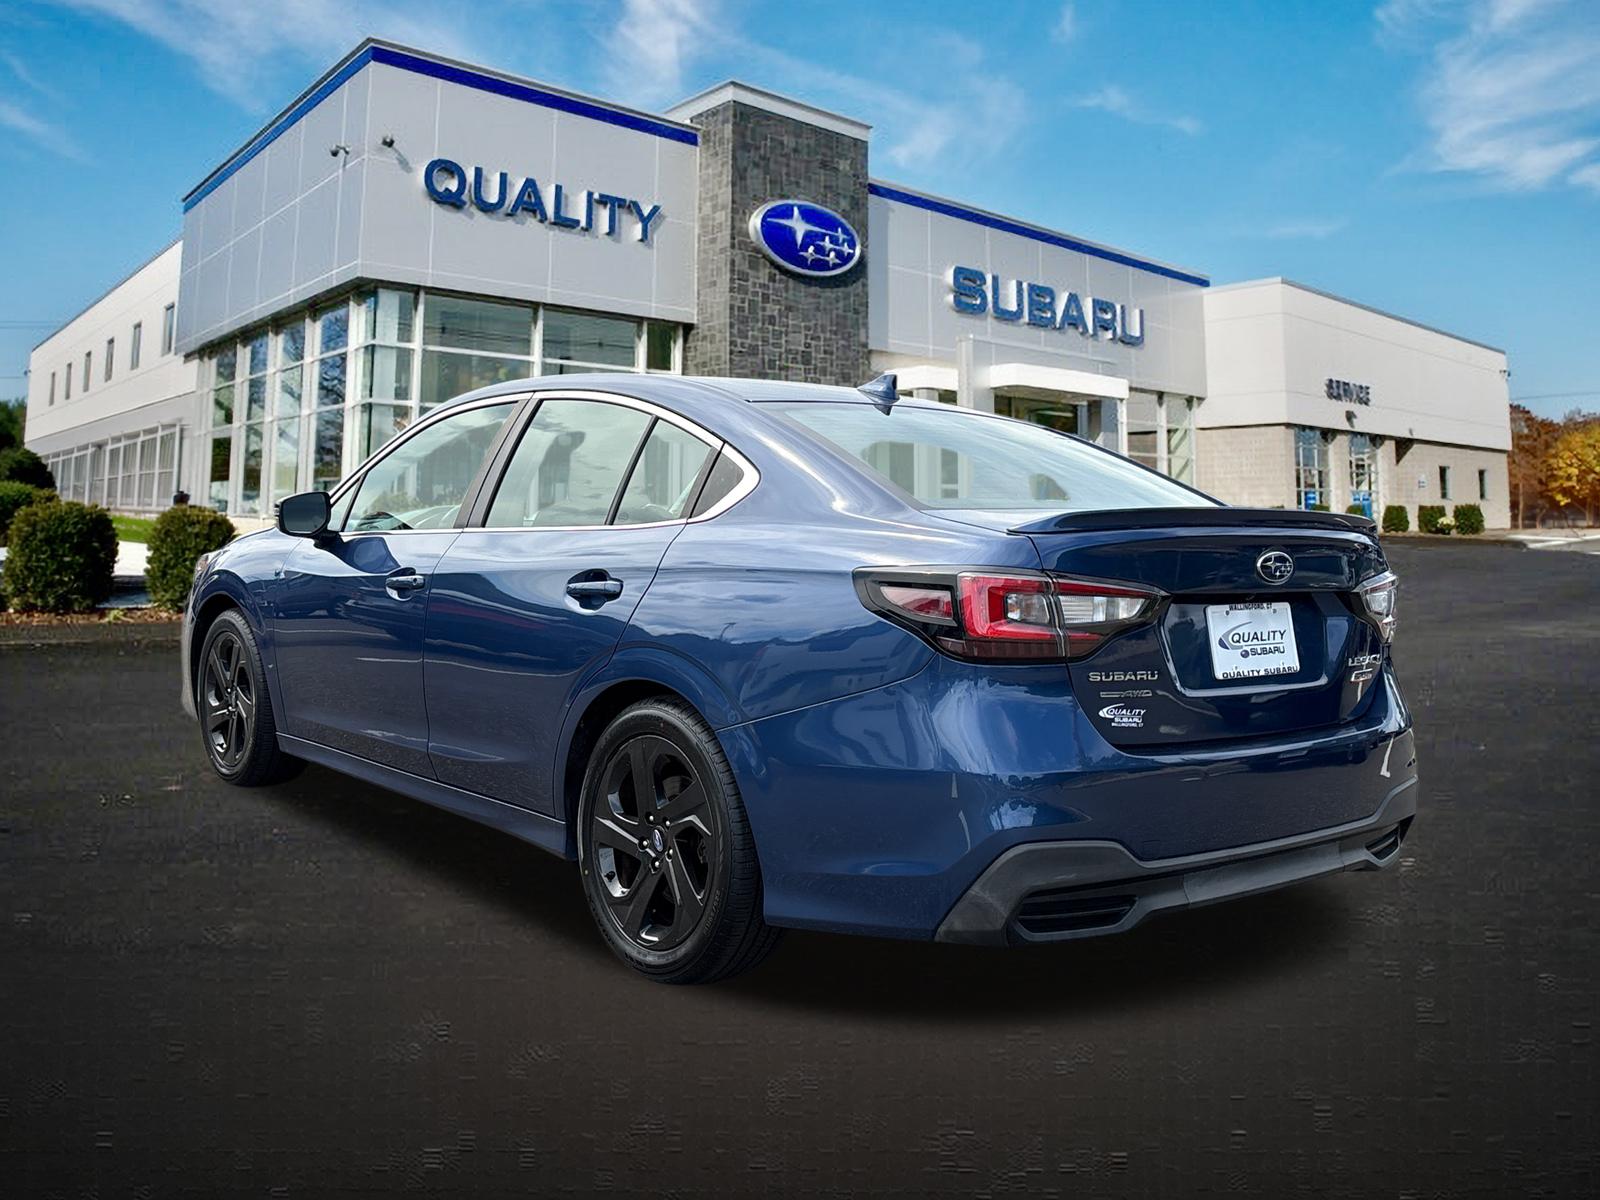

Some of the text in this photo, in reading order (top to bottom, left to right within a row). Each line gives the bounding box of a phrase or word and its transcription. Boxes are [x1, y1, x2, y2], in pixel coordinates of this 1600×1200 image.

[423, 158, 661, 242] QUALITY
[949, 265, 1145, 347] SUBARU
[1325, 378, 1370, 406] SERVICE
[1231, 629, 1286, 644] QUALITY
[1249, 646, 1285, 656] SUBARU
[1088, 670, 1158, 681] SUBARU
[1222, 665, 1299, 679] QUALITY SUBARU
[1107, 708, 1146, 716] QUALITY
